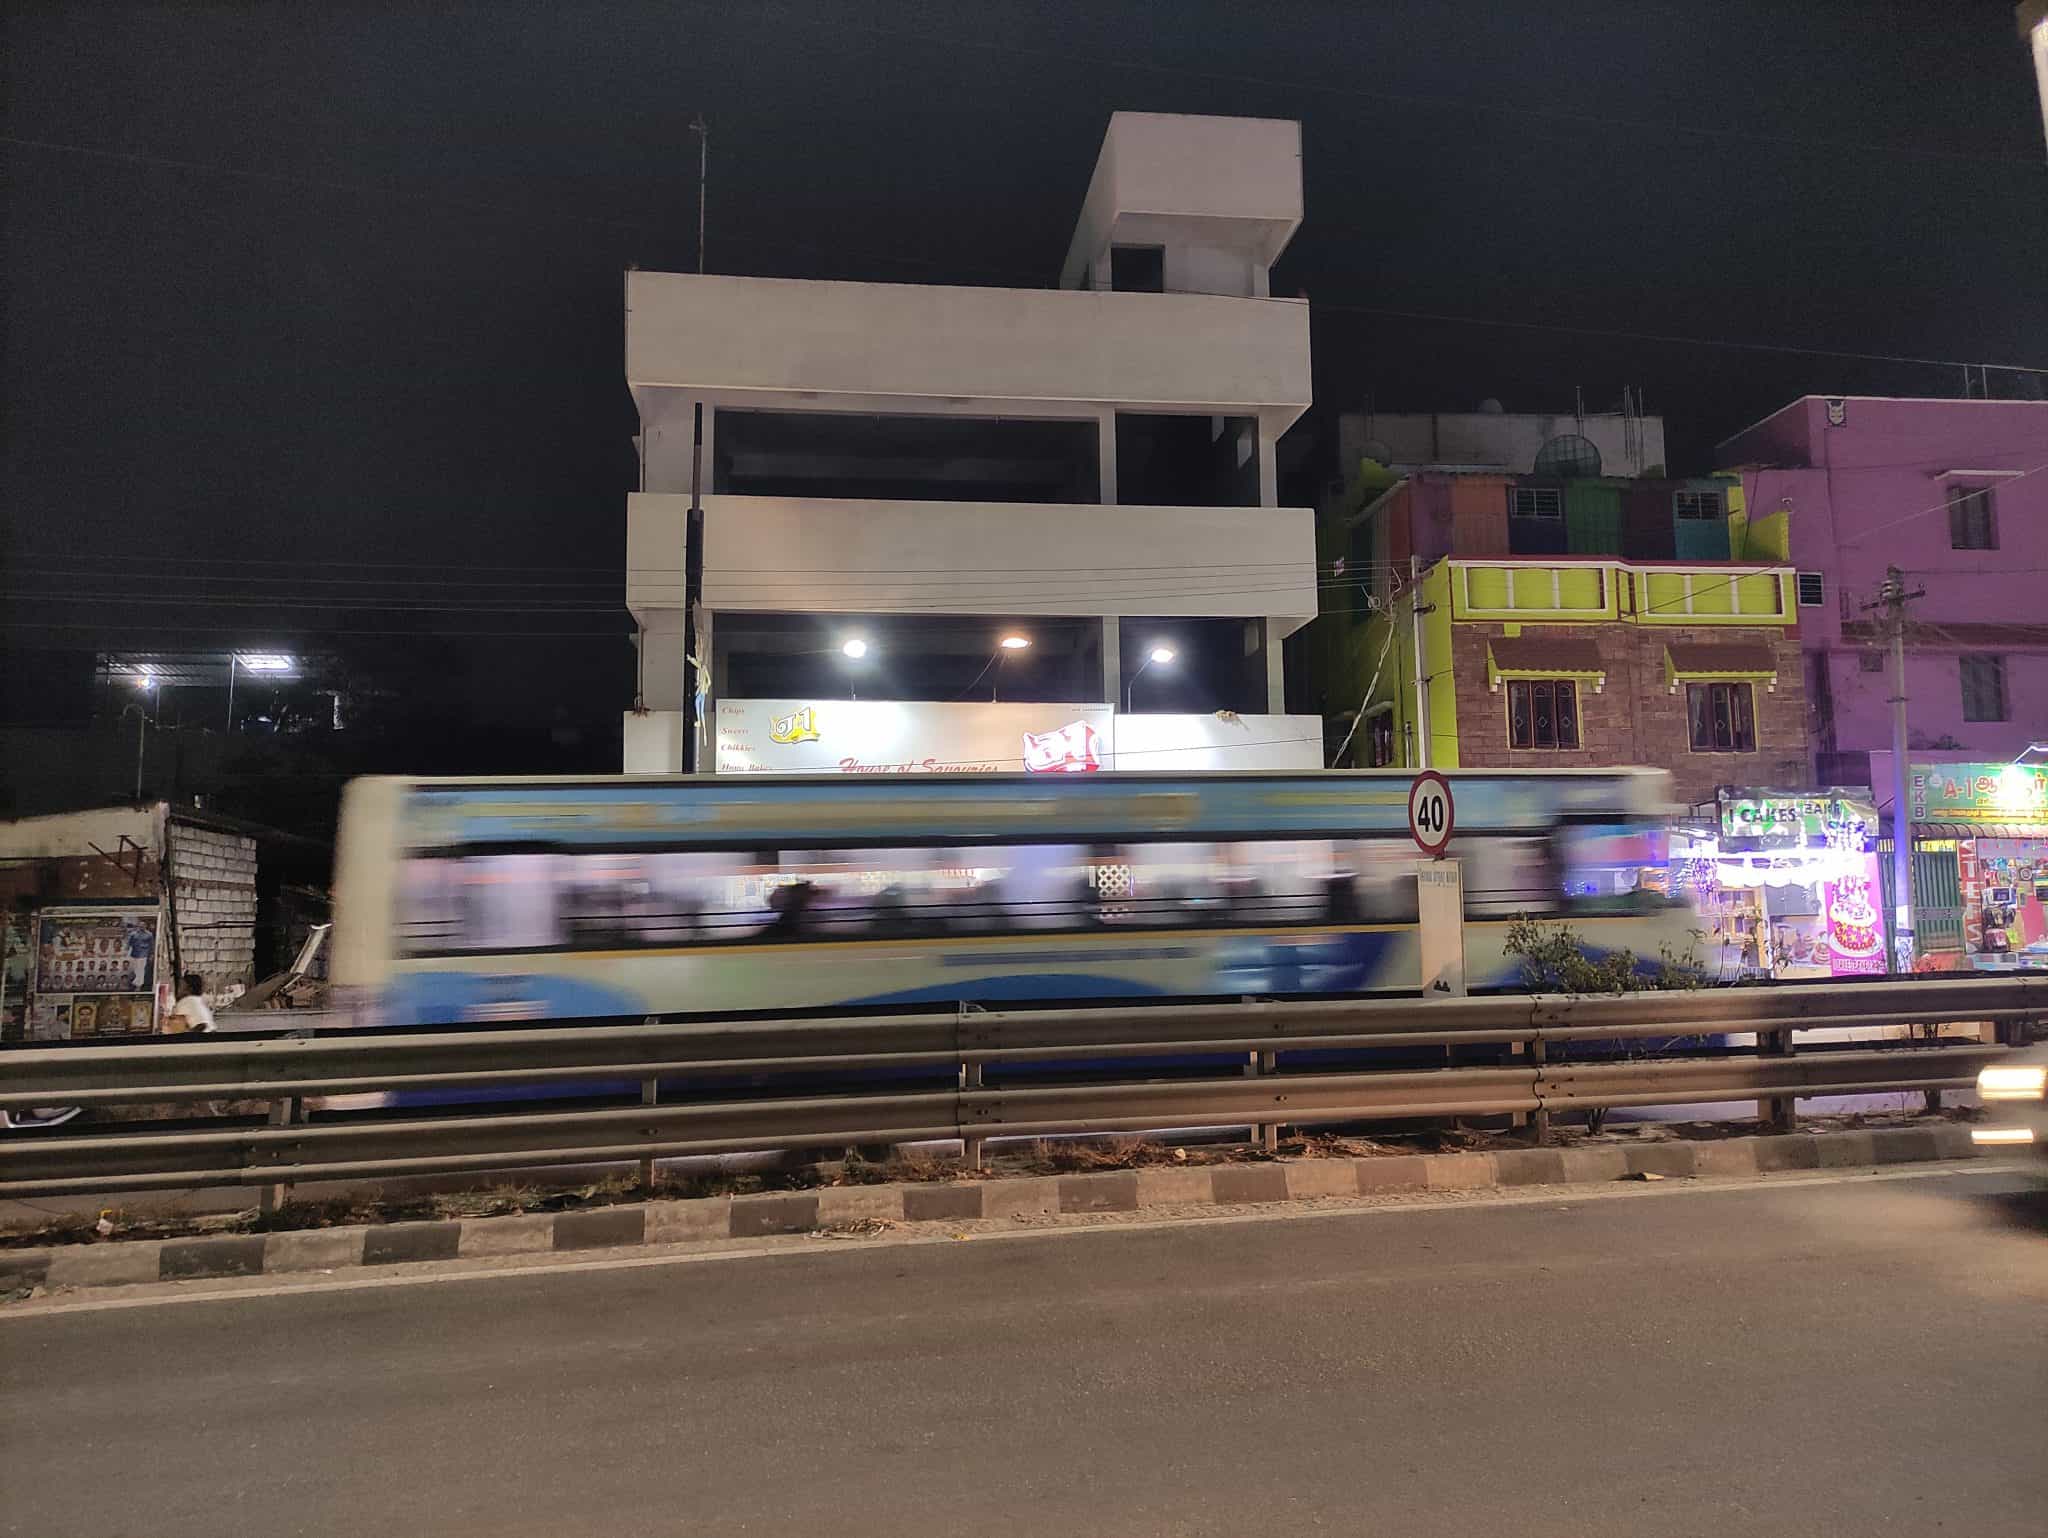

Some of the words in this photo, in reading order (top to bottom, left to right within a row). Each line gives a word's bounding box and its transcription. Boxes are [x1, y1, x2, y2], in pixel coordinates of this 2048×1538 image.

[839, 757, 890, 773] House
[898, 760, 914, 773] of
[1418, 796, 1444, 832] 40
[1740, 807, 1797, 823] CAKES
